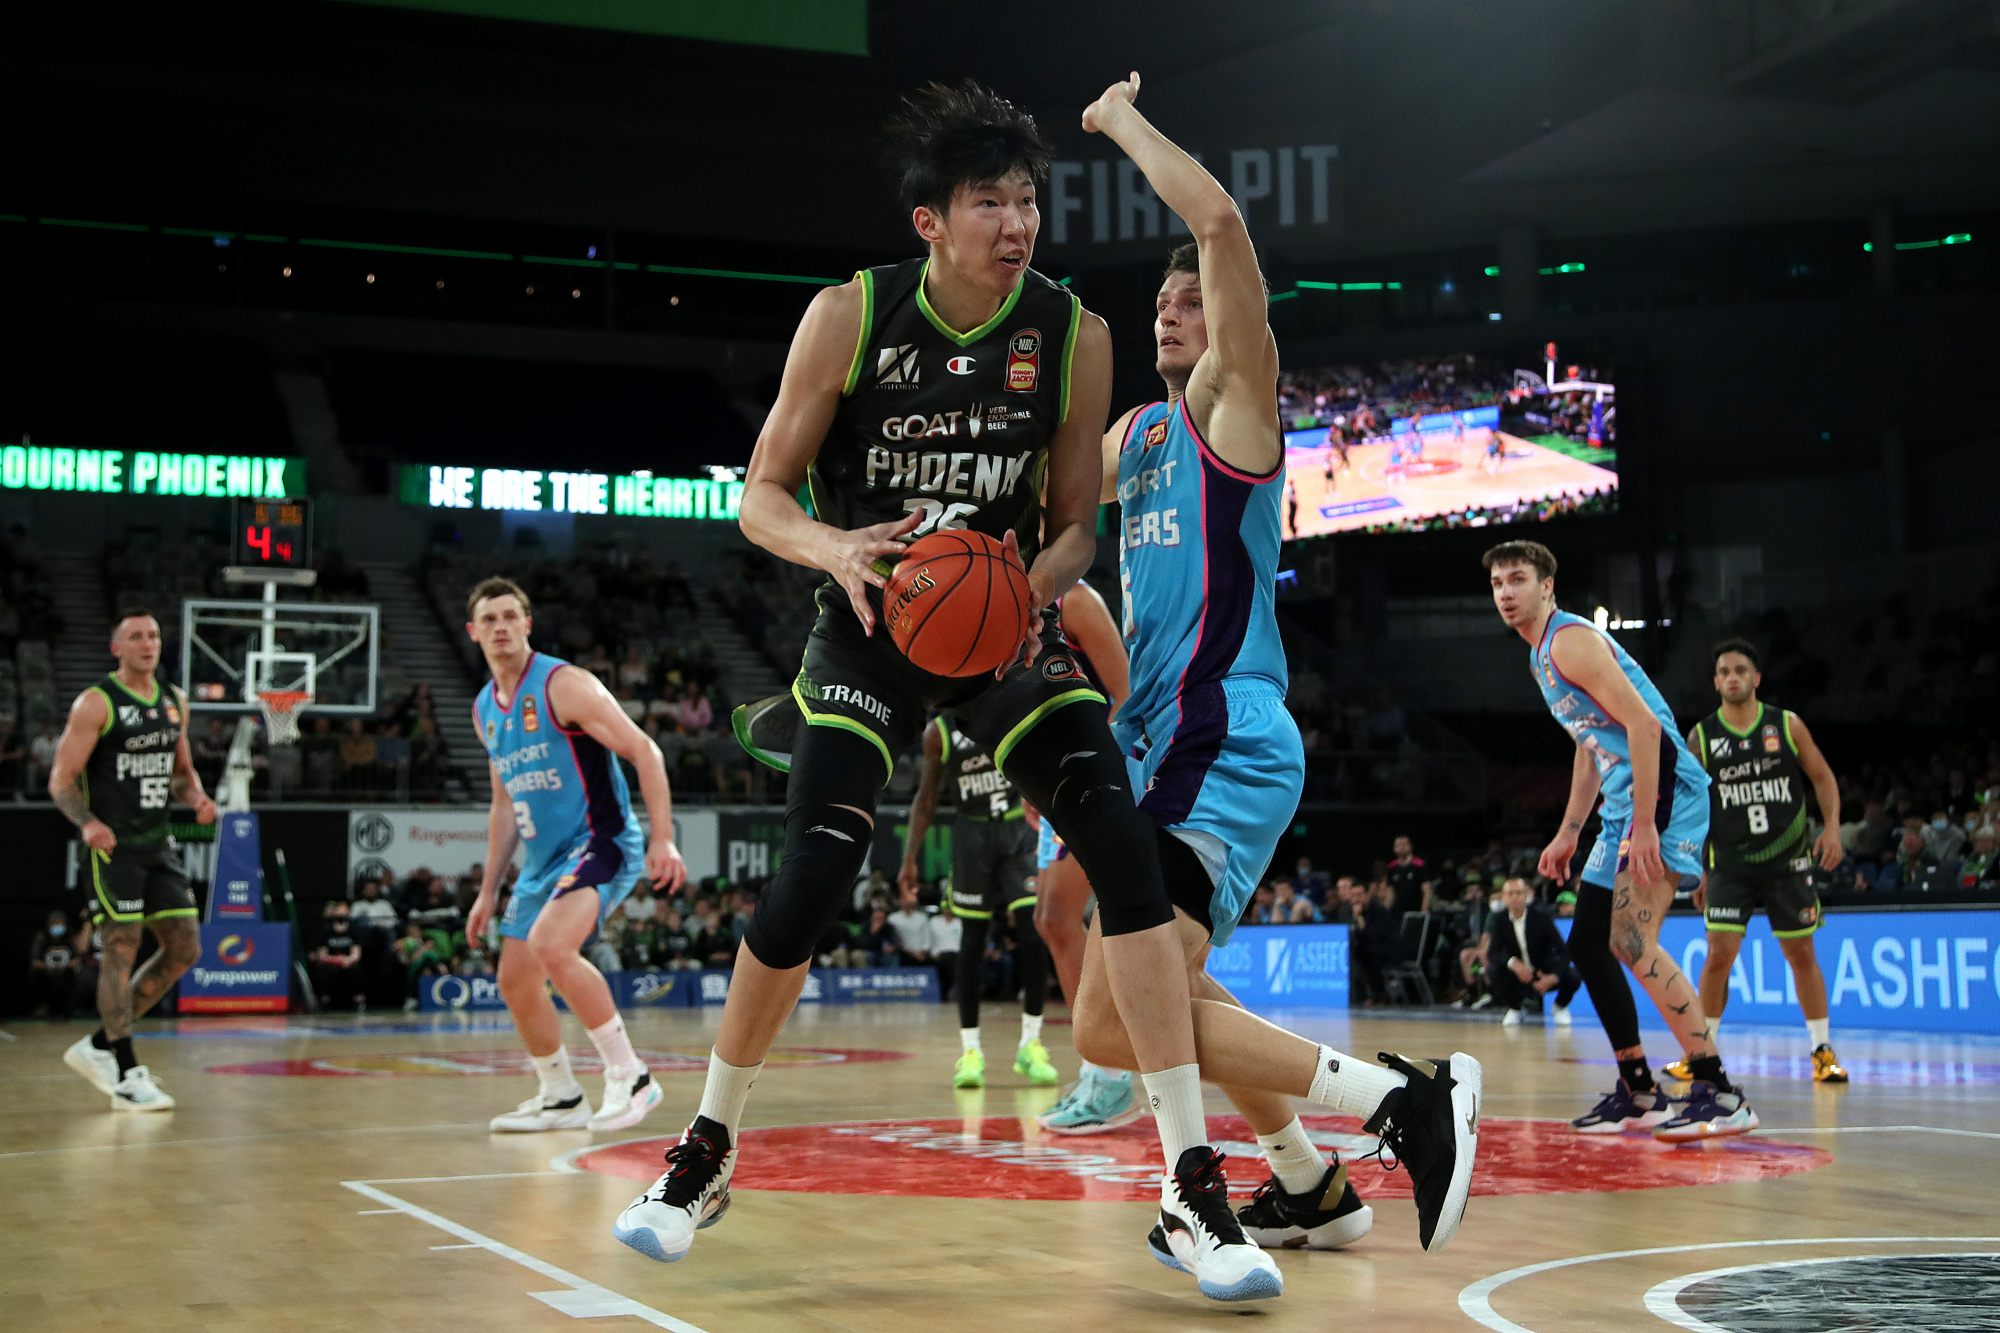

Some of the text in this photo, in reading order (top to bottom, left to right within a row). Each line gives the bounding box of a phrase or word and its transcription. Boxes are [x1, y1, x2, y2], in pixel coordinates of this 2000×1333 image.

[1051, 145, 1338, 243] FIR PIT
[1018, 338, 1034, 350] NBL
[987, 411, 1031, 422] ENJOYABLE
[989, 406, 1007, 414] VERY
[882, 411, 963, 441] GOAT
[987, 422, 1007, 431] BEER
[0, 446, 286, 498] OURNE PHOENIX
[429, 466, 475, 508] WE
[481, 468, 543, 511] ARE
[548, 472, 608, 514] THE
[247, 526, 271, 561] 4
[1050, 662, 1069, 674] NBL
[822, 685, 892, 726] TRADIE
[1719, 761, 1752, 783] GOAT
[140, 777, 170, 809] 55
[1718, 776, 1793, 810] PHOENIX
[1747, 804, 1769, 835] 8
[1831, 936, 2000, 1010] ASHF
